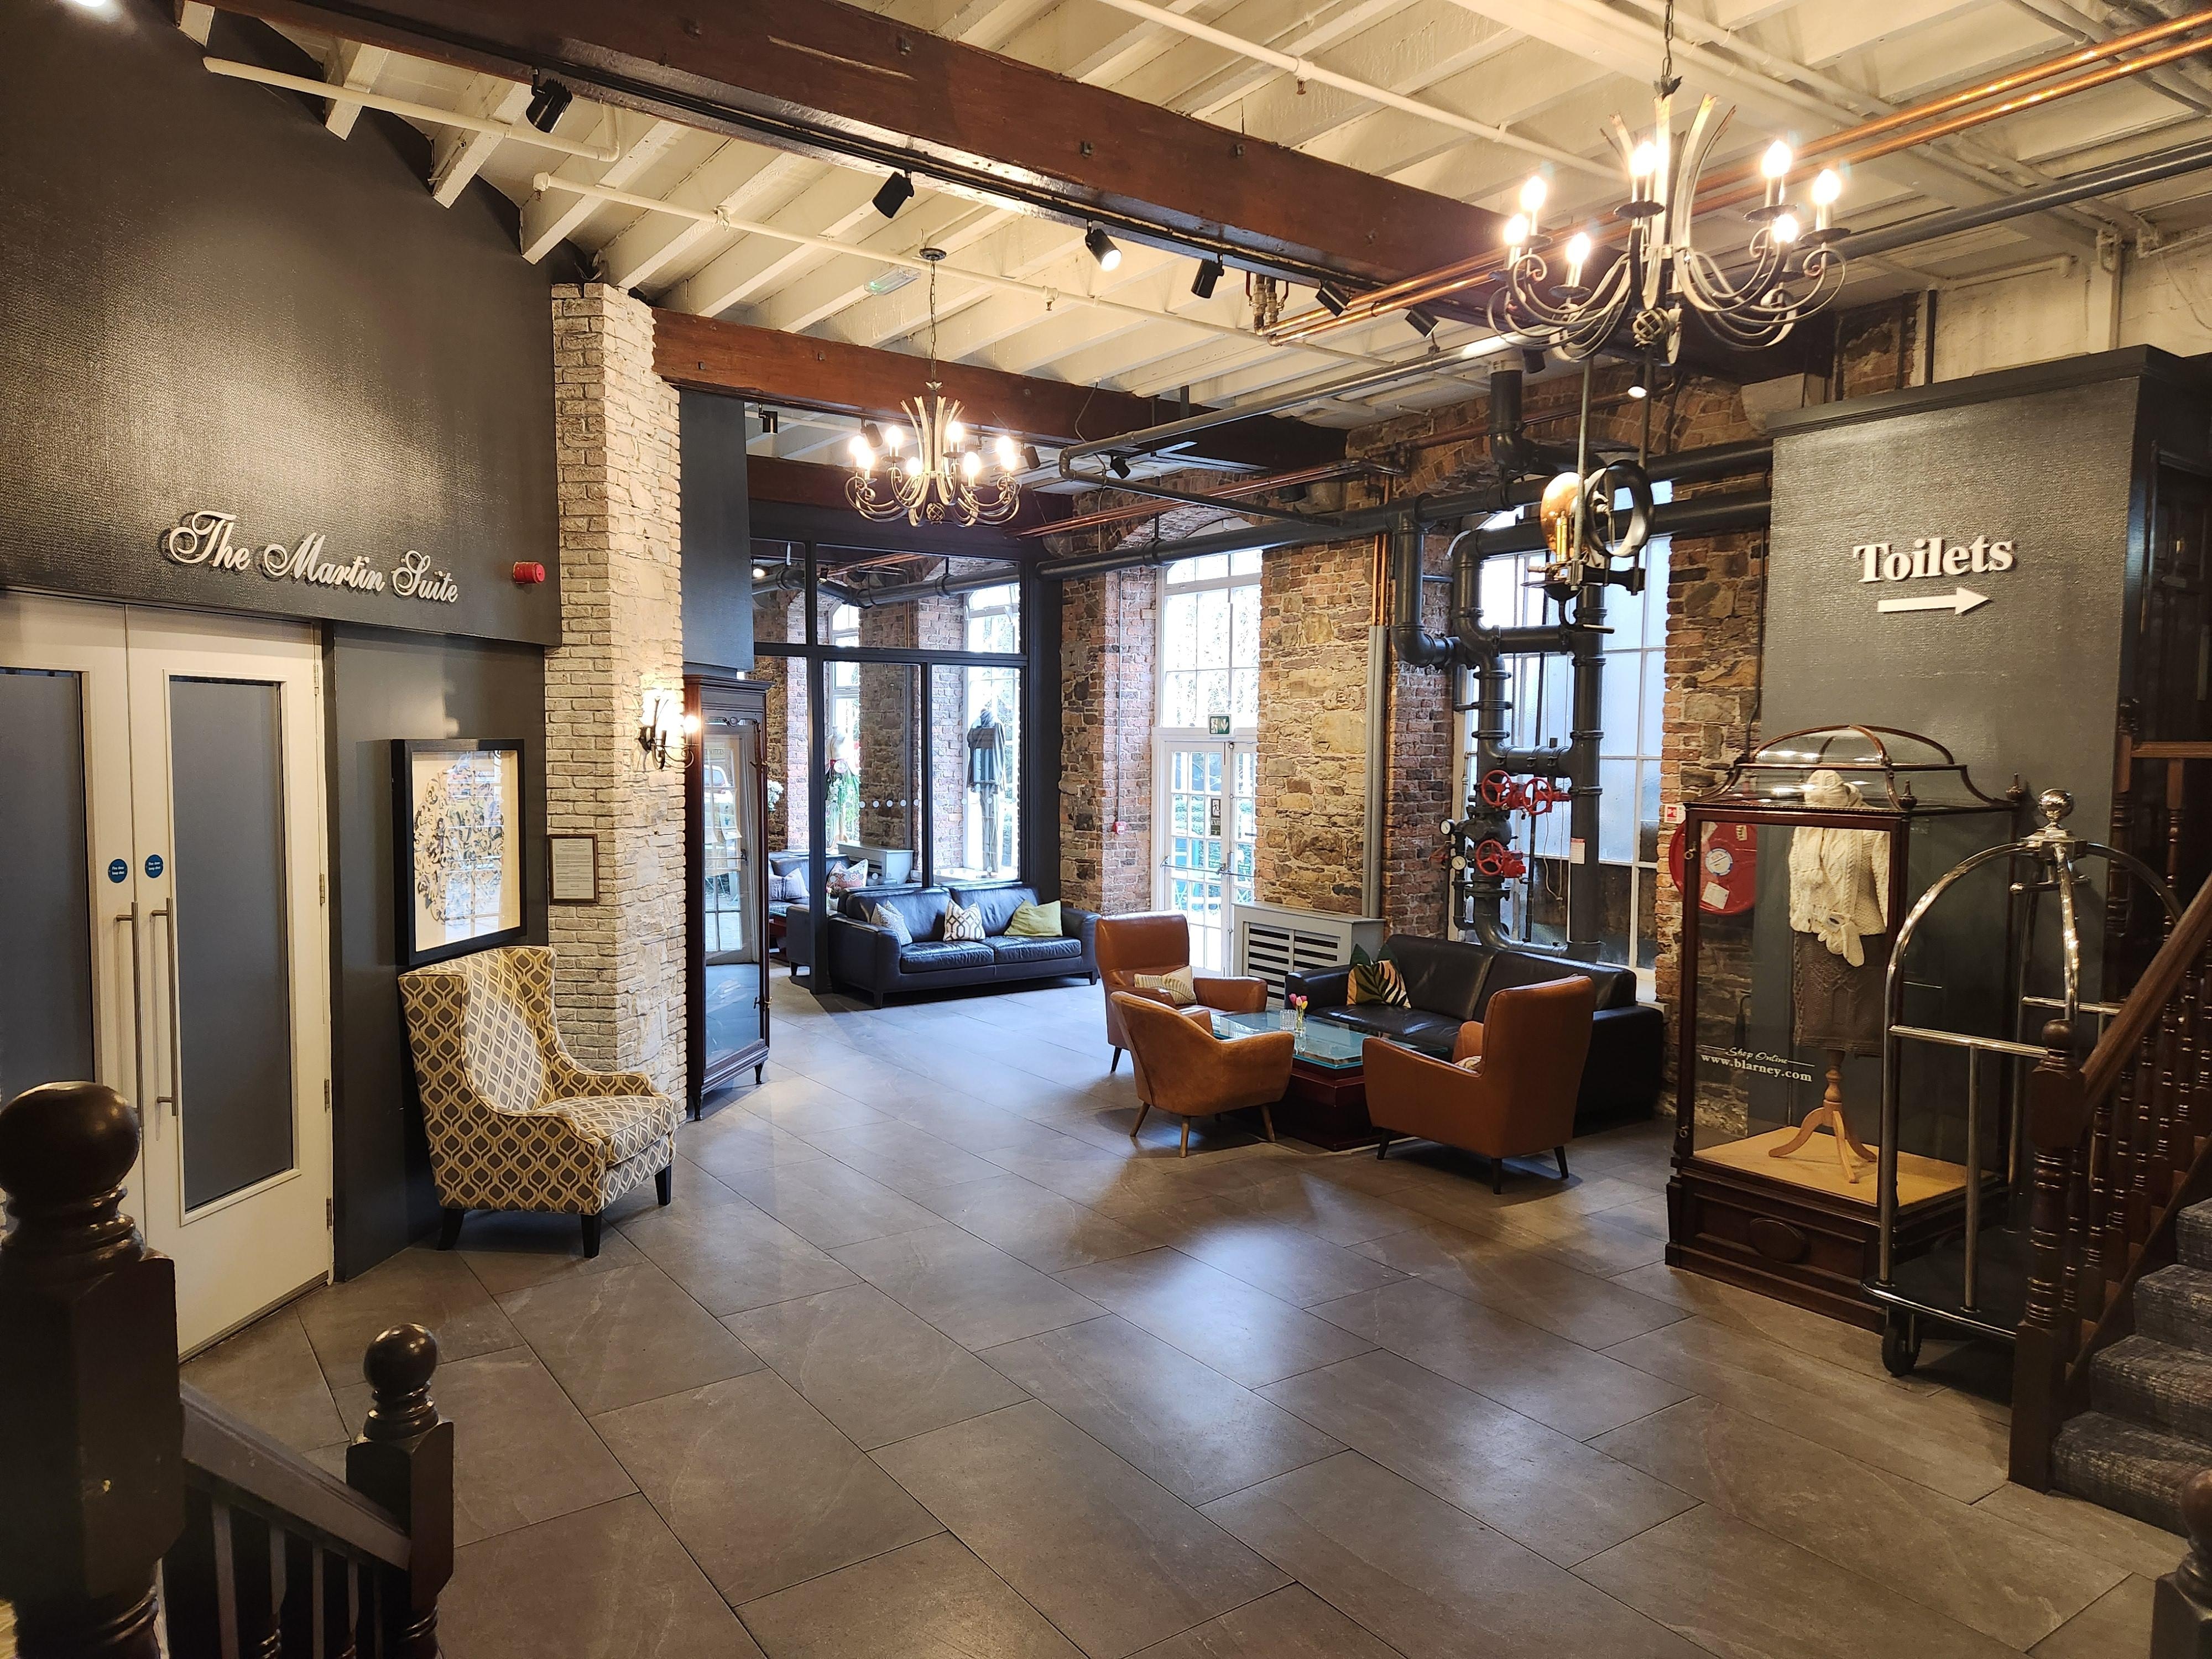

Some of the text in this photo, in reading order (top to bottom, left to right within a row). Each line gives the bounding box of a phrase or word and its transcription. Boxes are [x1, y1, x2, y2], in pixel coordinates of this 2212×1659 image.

[169, 510, 458, 603] The Martin Suite
[1852, 534, 2015, 583] Toilets
[1700, 1054, 1813, 1082] www.blarney.com
[1725, 1047, 1788, 1064] Shop Online
